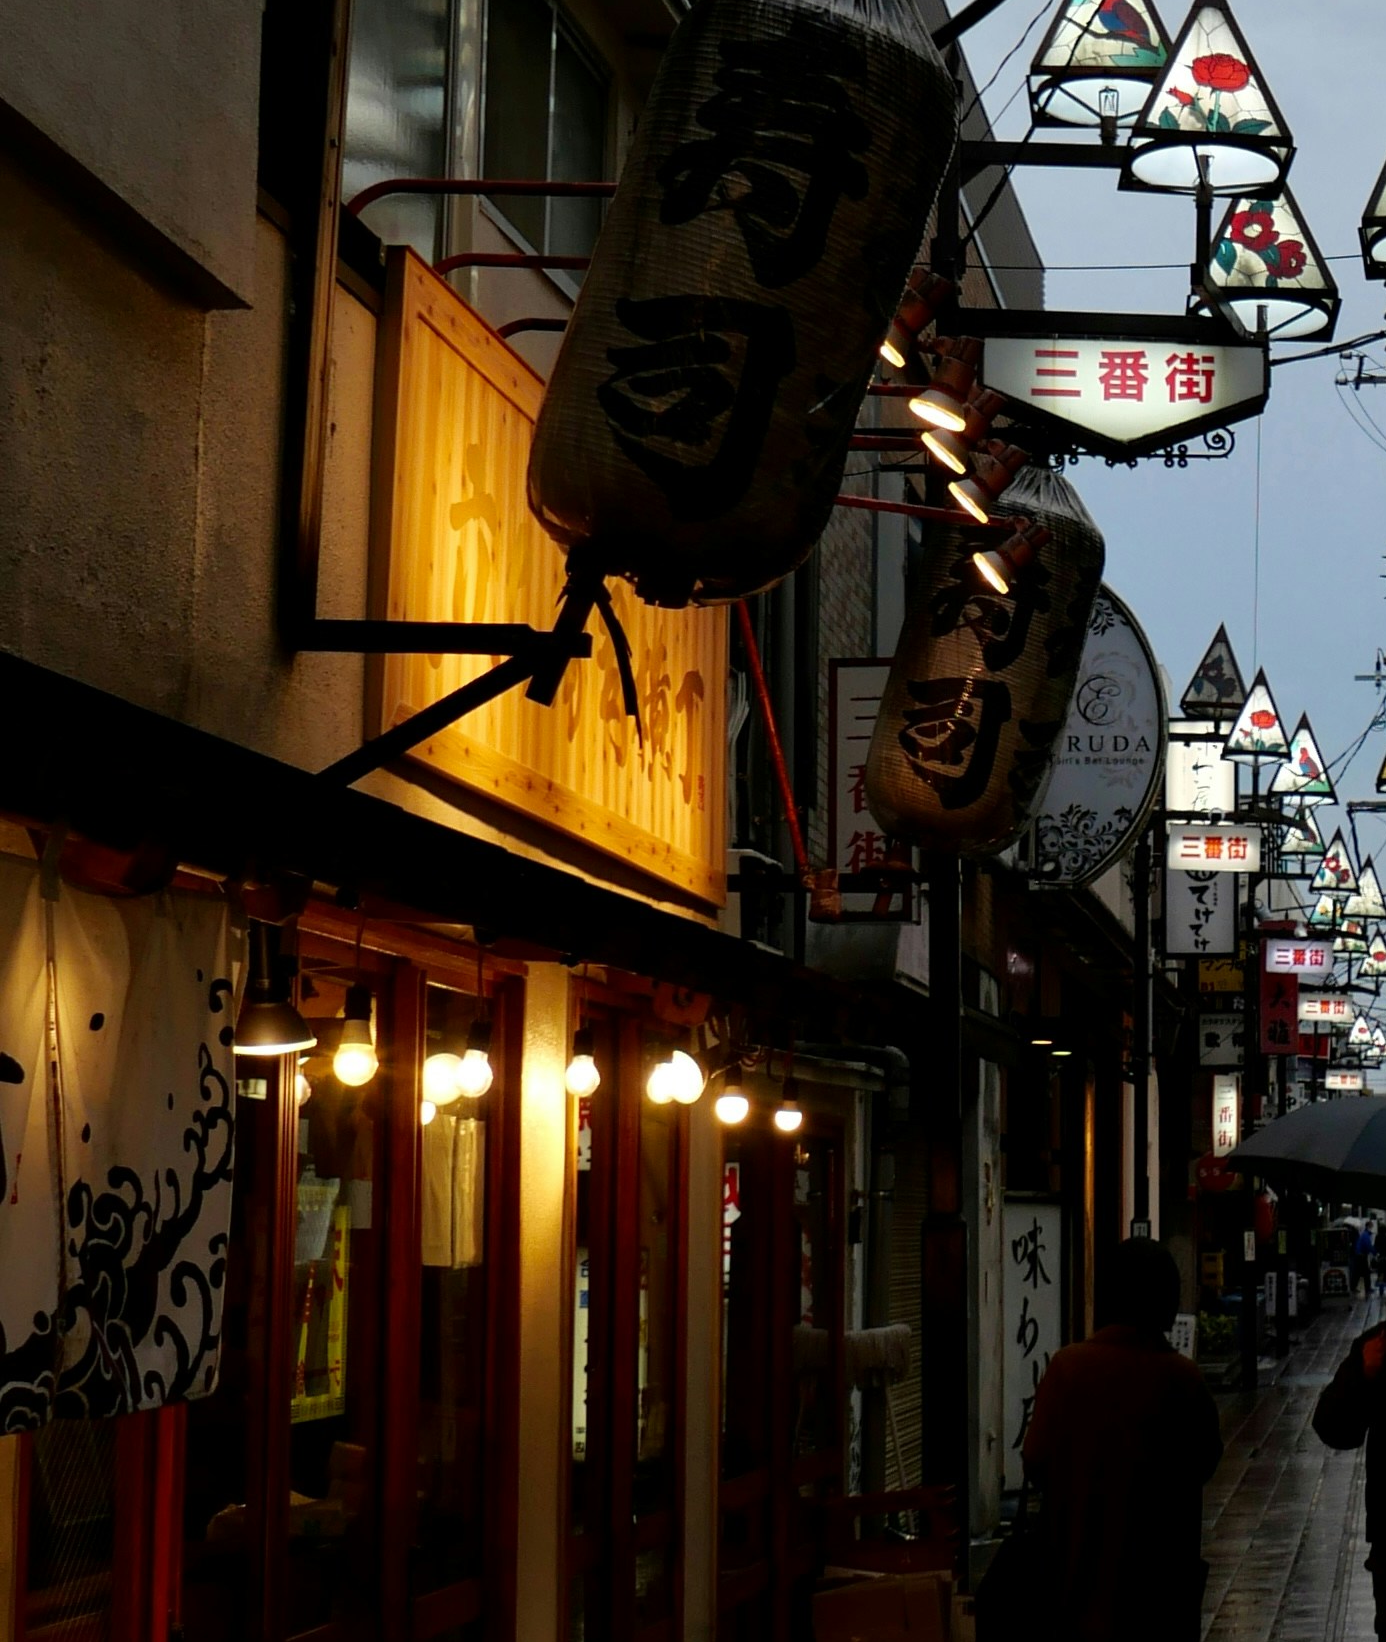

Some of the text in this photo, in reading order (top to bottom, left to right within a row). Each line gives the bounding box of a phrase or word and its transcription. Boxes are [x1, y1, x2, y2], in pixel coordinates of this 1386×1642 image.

[600, 38, 871, 523] 寿司
[1031, 350, 1215, 404] 三番街
[1106, 757, 1145, 768] Lounge
[1181, 836, 1248, 860] 三番街
[1188, 885, 1214, 952] てけてけ
[1275, 948, 1325, 967] 三番街
[1305, 999, 1346, 1015] 三番街
